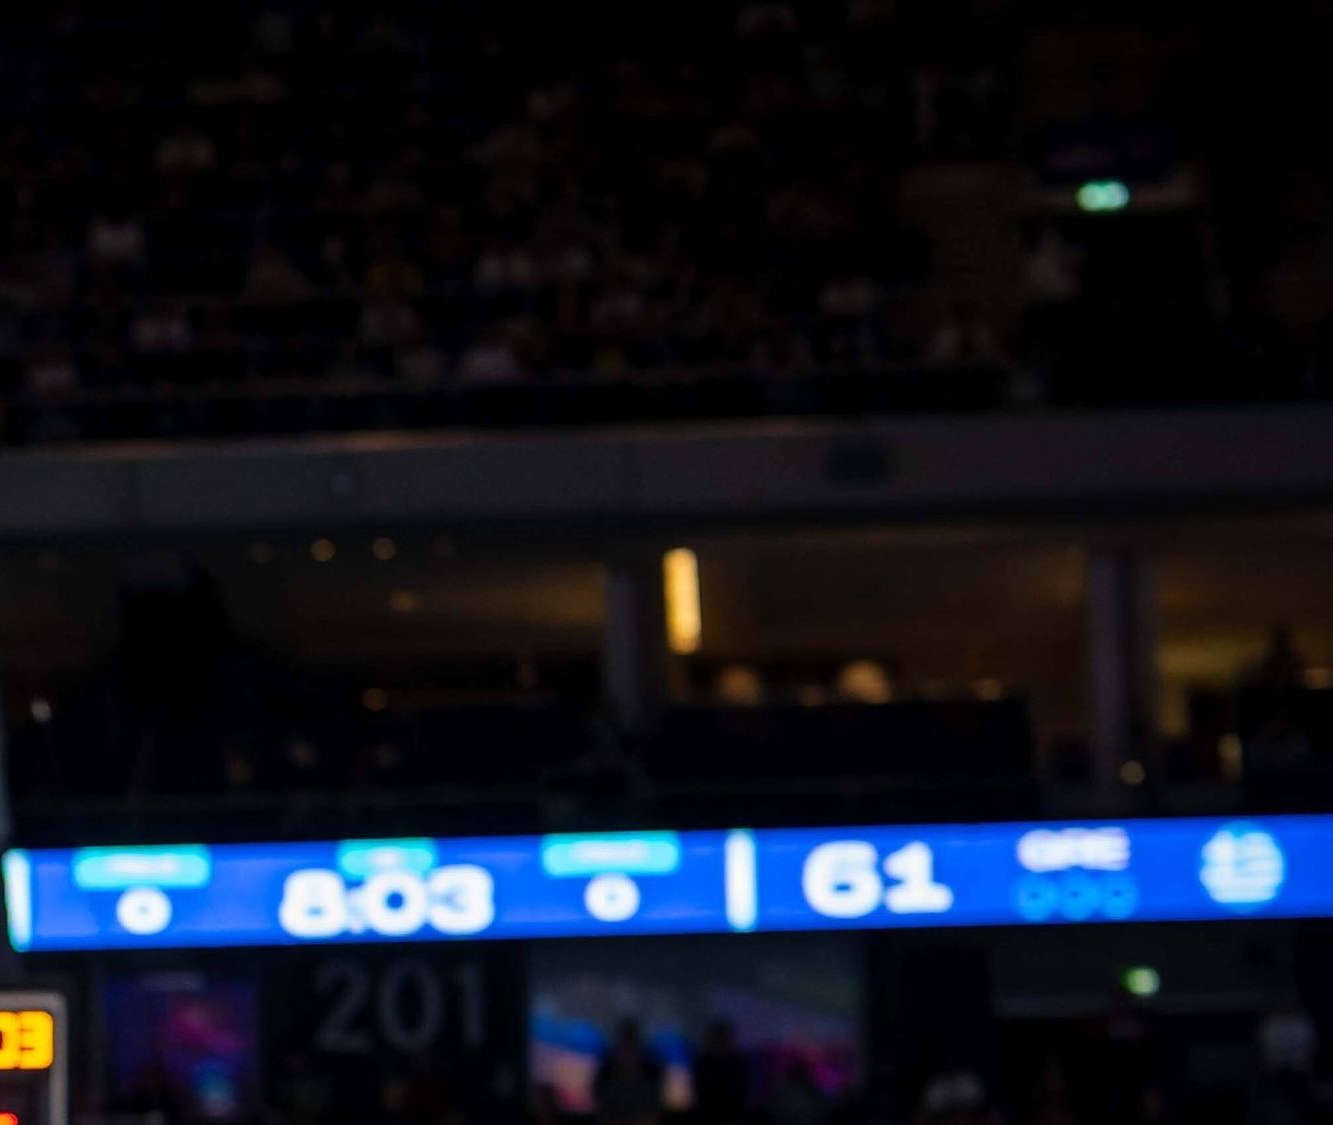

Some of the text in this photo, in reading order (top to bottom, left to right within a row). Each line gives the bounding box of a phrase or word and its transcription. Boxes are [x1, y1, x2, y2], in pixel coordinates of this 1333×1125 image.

[116, 886, 173, 935] 0
[278, 865, 494, 938] 8:03
[584, 873, 640, 922] 0
[802, 840, 954, 918] 61
[313, 956, 483, 1054] 201
